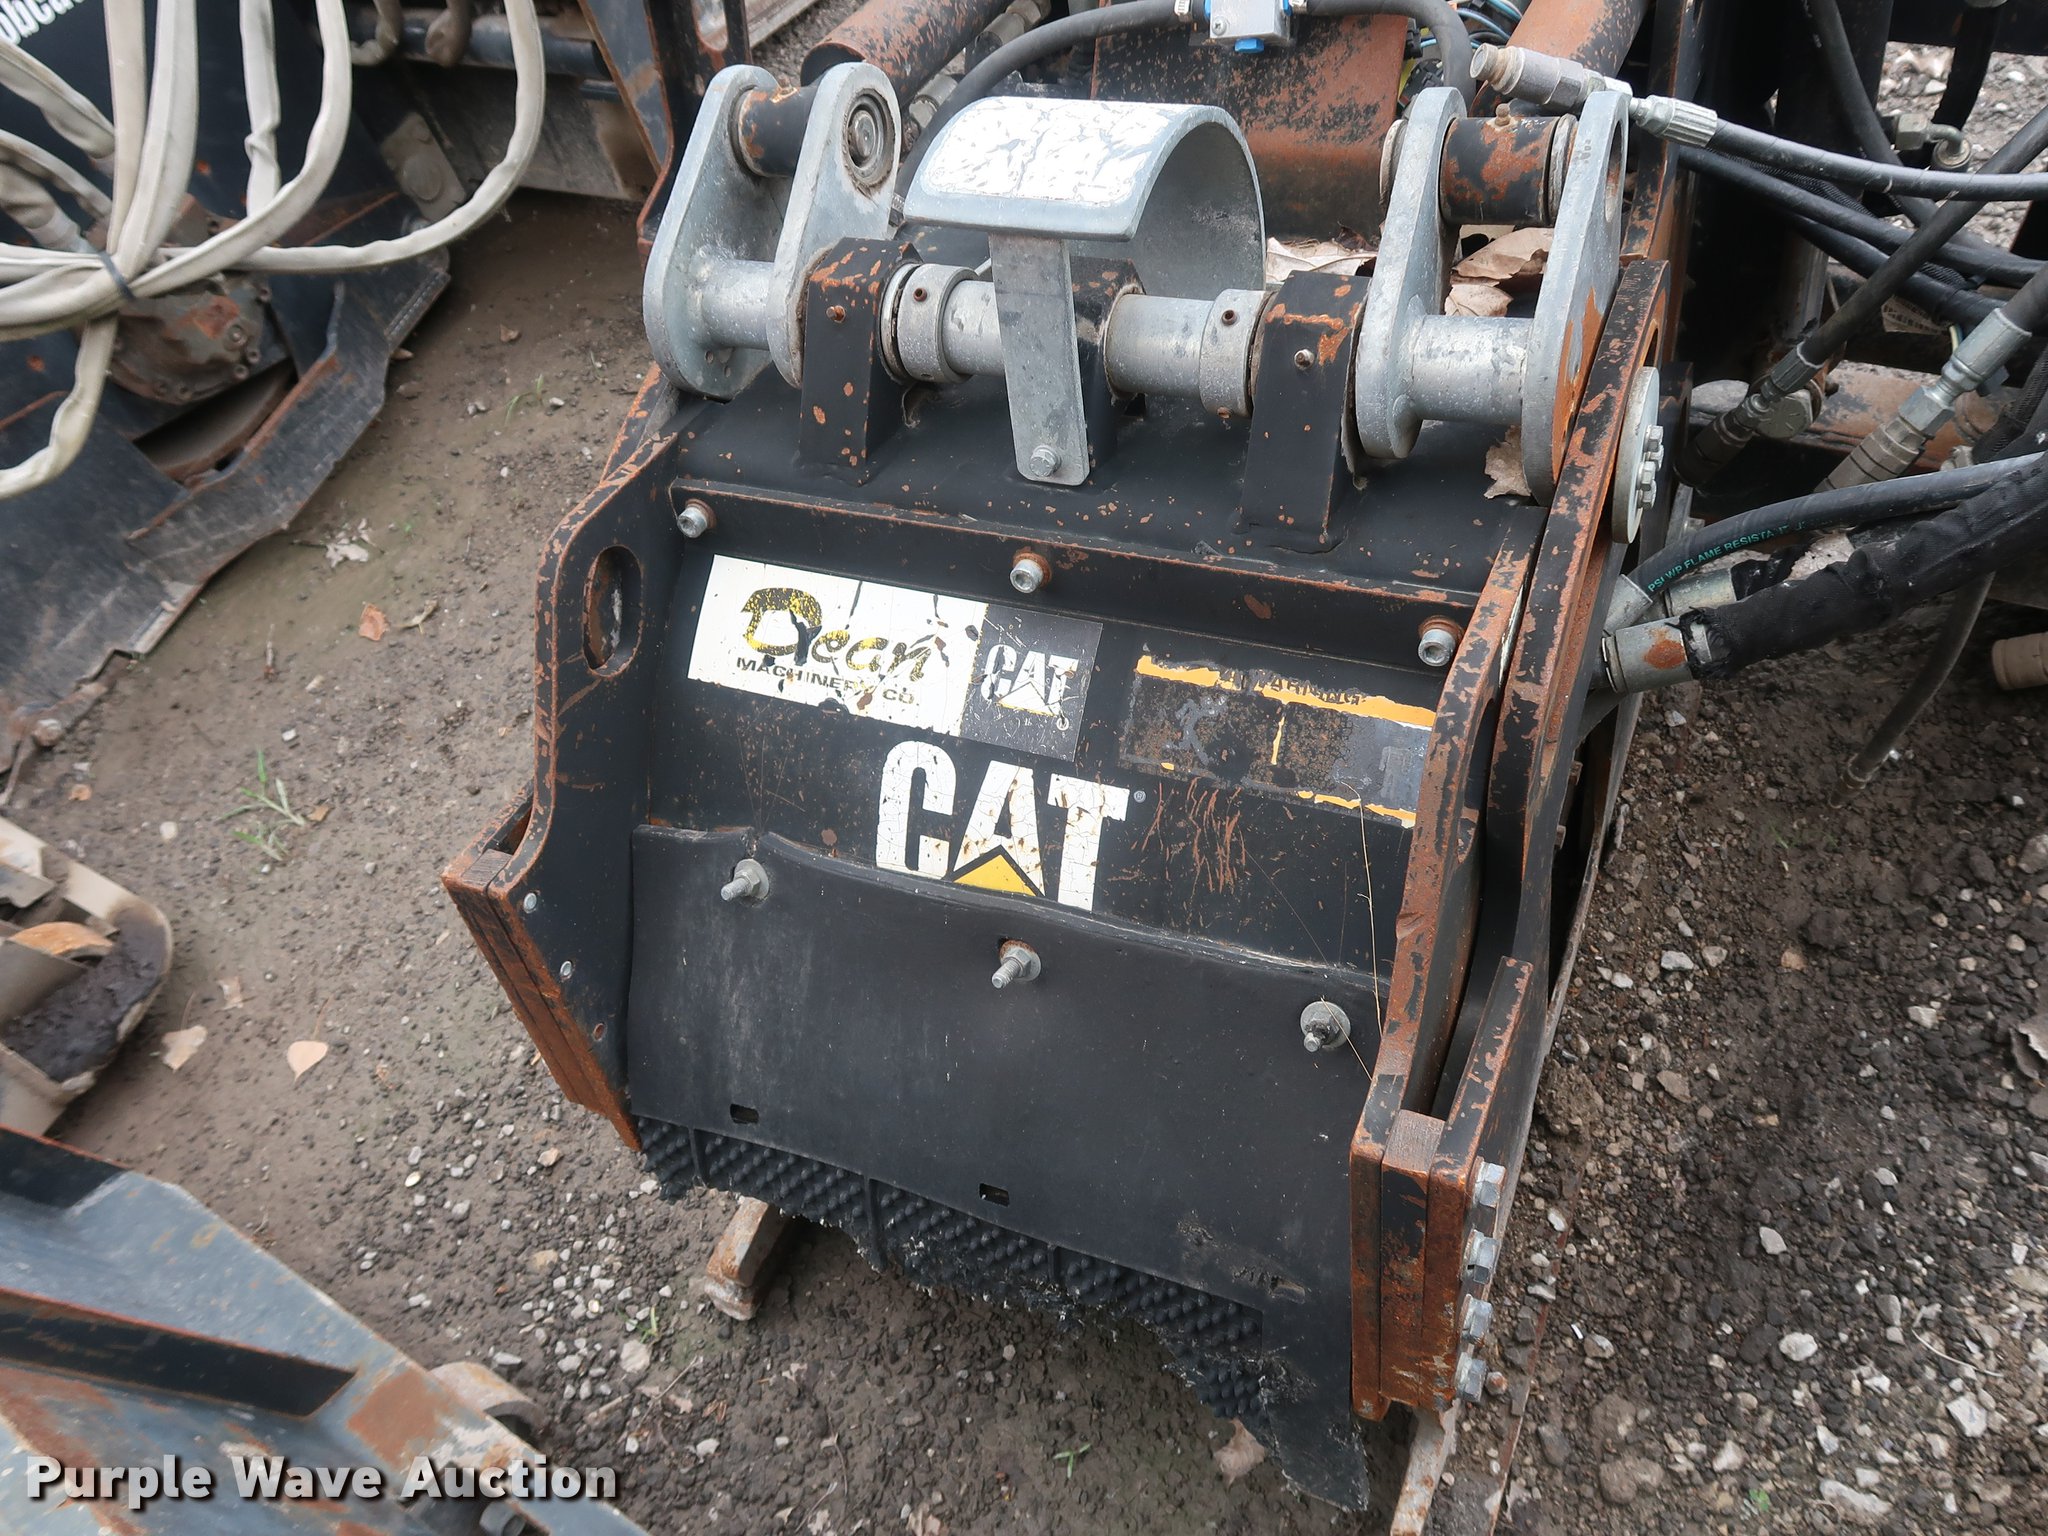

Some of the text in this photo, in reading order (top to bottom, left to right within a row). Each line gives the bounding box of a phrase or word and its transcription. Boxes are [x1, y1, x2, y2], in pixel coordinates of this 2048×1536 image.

[1683, 546, 1722, 568] FLAME
[1723, 524, 1788, 551] RESISTAT
[981, 644, 1079, 716] CAT
